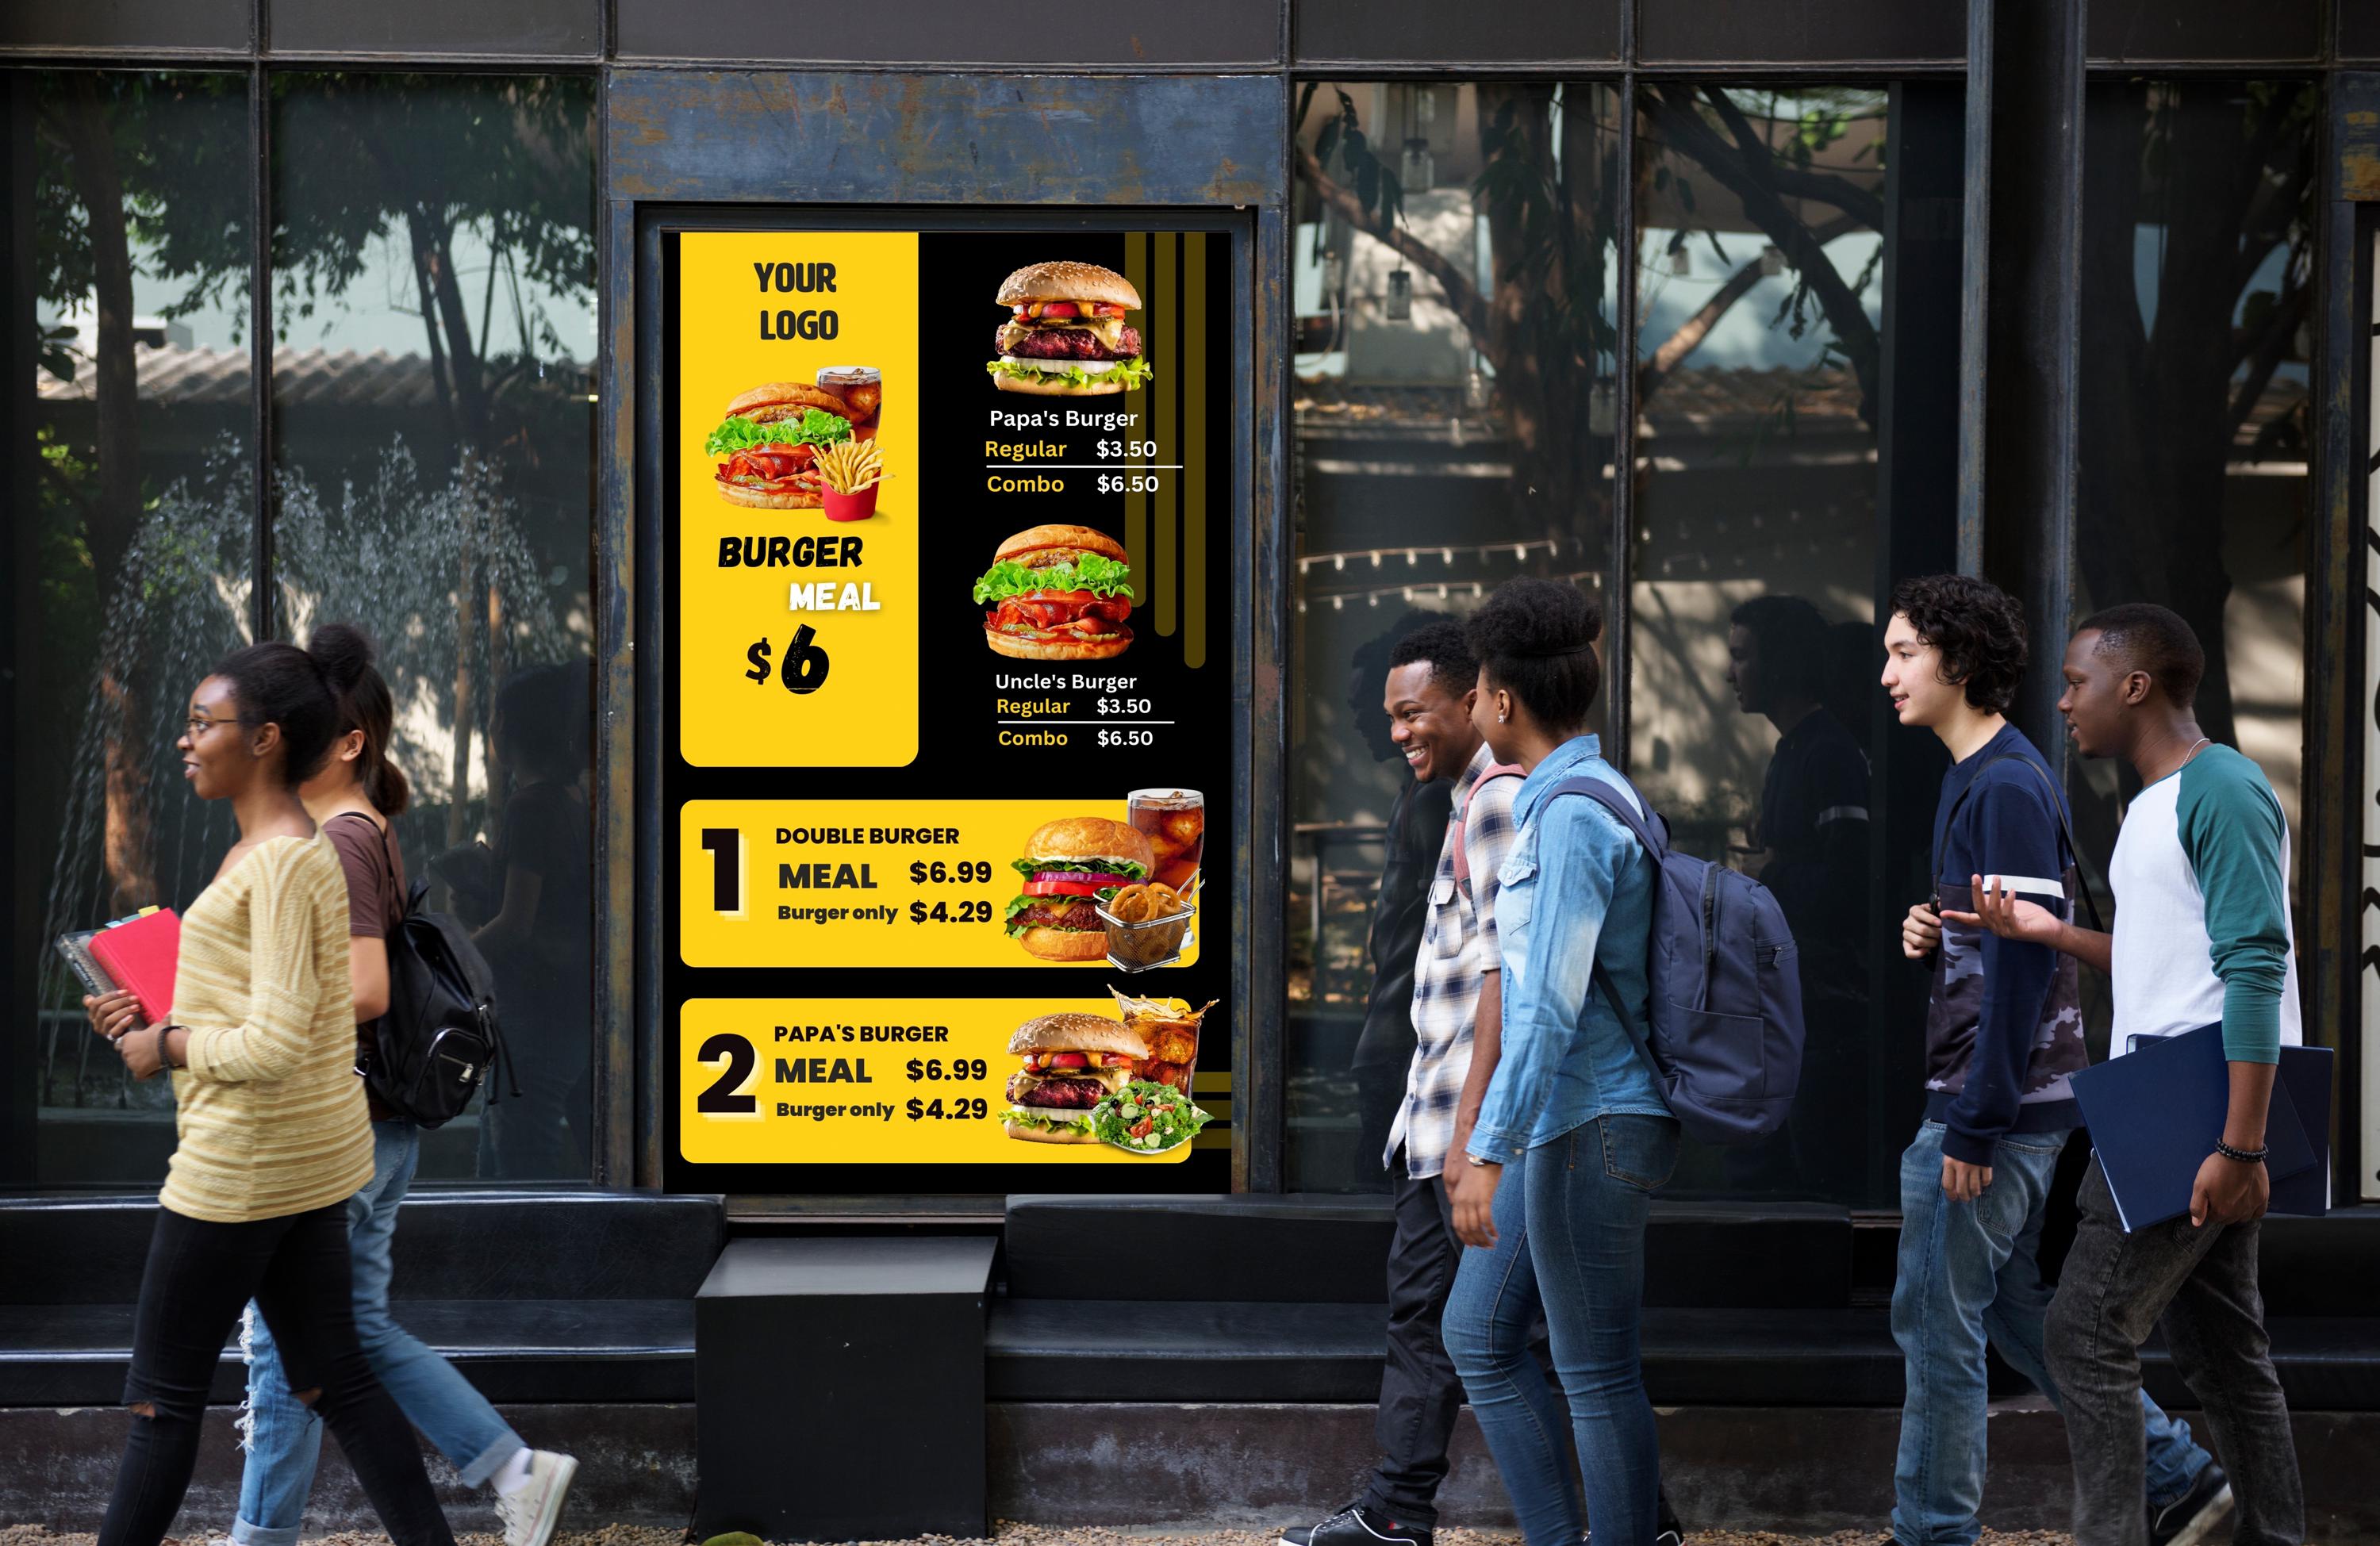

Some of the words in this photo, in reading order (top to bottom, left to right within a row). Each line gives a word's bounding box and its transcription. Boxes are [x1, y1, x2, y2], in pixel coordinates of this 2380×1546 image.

[754, 263, 837, 293] YOUR
[760, 310, 839, 340] LOGO
[990, 411, 1059, 432] Papa's
[1065, 411, 1138, 432] Burger
[985, 440, 1068, 462] Regular
[1096, 439, 1157, 459] $3.50
[987, 475, 1065, 493] Combo
[1096, 474, 1159, 495] $6.50
[718, 536, 863, 568] BURGER
[789, 582, 881, 611] MEAL
[996, 674, 1066, 689] Uncle's
[1072, 674, 1138, 693] Burger
[997, 698, 1071, 718] Regular
[1096, 697, 1152, 715] $3.50
[998, 730, 1068, 746] Combo
[1097, 729, 1154, 748] $6.50
[776, 827, 865, 845] DOUBLE
[869, 827, 960, 845] BURGER
[701, 828, 740, 912] 1
[778, 863, 878, 889] MEAL
[909, 860, 992, 885] $6.99
[777, 905, 850, 925] Burger
[852, 905, 898, 925] only
[909, 900, 992, 925] $4.29
[774, 1023, 855, 1042] PAPA'S
[860, 1026, 949, 1042] BURGER
[697, 1033, 757, 1114] 2
[774, 1058, 873, 1084] MEAL
[906, 1057, 988, 1084] $6.99
[777, 1102, 847, 1122] Burger
[850, 1102, 895, 1122] only
[906, 1097, 988, 1122] $4.29
